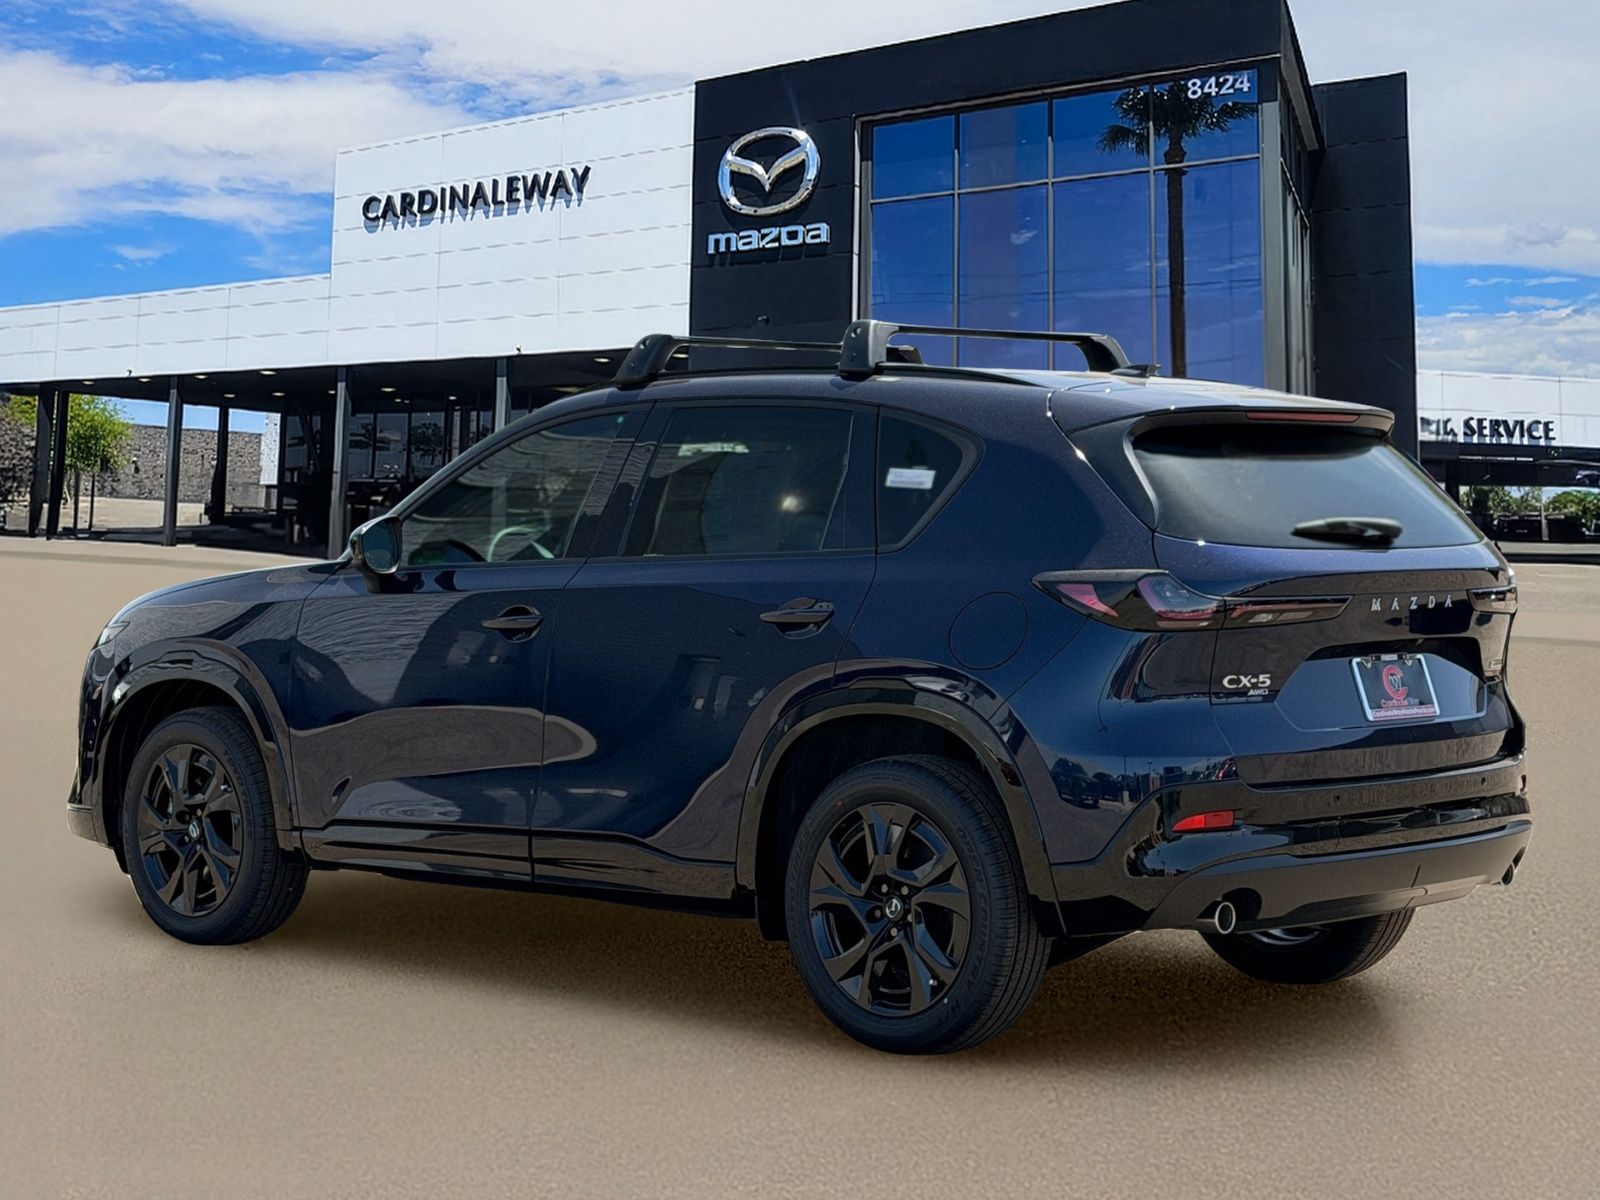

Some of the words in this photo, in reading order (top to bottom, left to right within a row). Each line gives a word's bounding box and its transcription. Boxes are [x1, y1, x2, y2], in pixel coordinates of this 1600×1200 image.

[1187, 74, 1250, 99] 8424
[362, 164, 591, 222] CARDINALEWAY
[1463, 416, 1556, 440] SERVICE
[1371, 595, 1452, 611] MAZDA
[1222, 674, 1271, 688] CX-5
[1247, 688, 1269, 697] AWD
